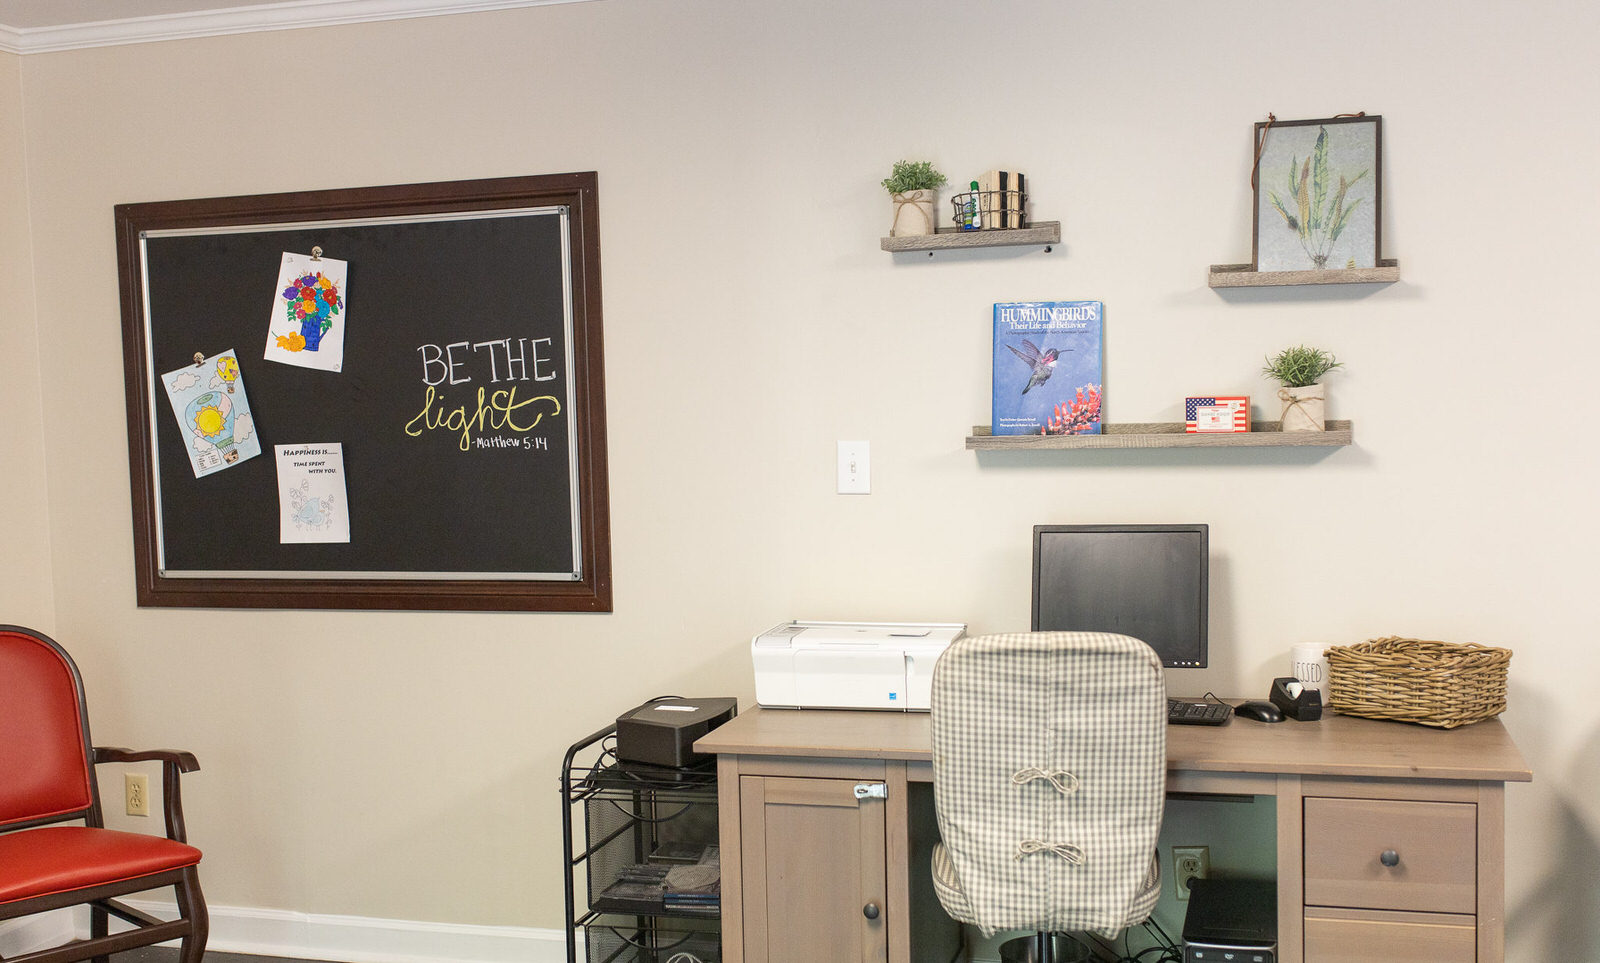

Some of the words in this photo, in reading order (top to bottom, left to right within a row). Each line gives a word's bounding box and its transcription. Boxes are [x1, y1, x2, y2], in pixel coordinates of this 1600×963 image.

[1000, 306, 1096, 322] HUMMINGBIRDS
[1010, 321, 1029, 330] Their
[1030, 320, 1042, 330] Life
[1042, 321, 1056, 329] and
[1057, 320, 1087, 329] Behavior
[417, 341, 472, 386] BE
[473, 337, 556, 382] THE
[405, 386, 561, 451] light
[523, 437, 548, 451] 5:14
